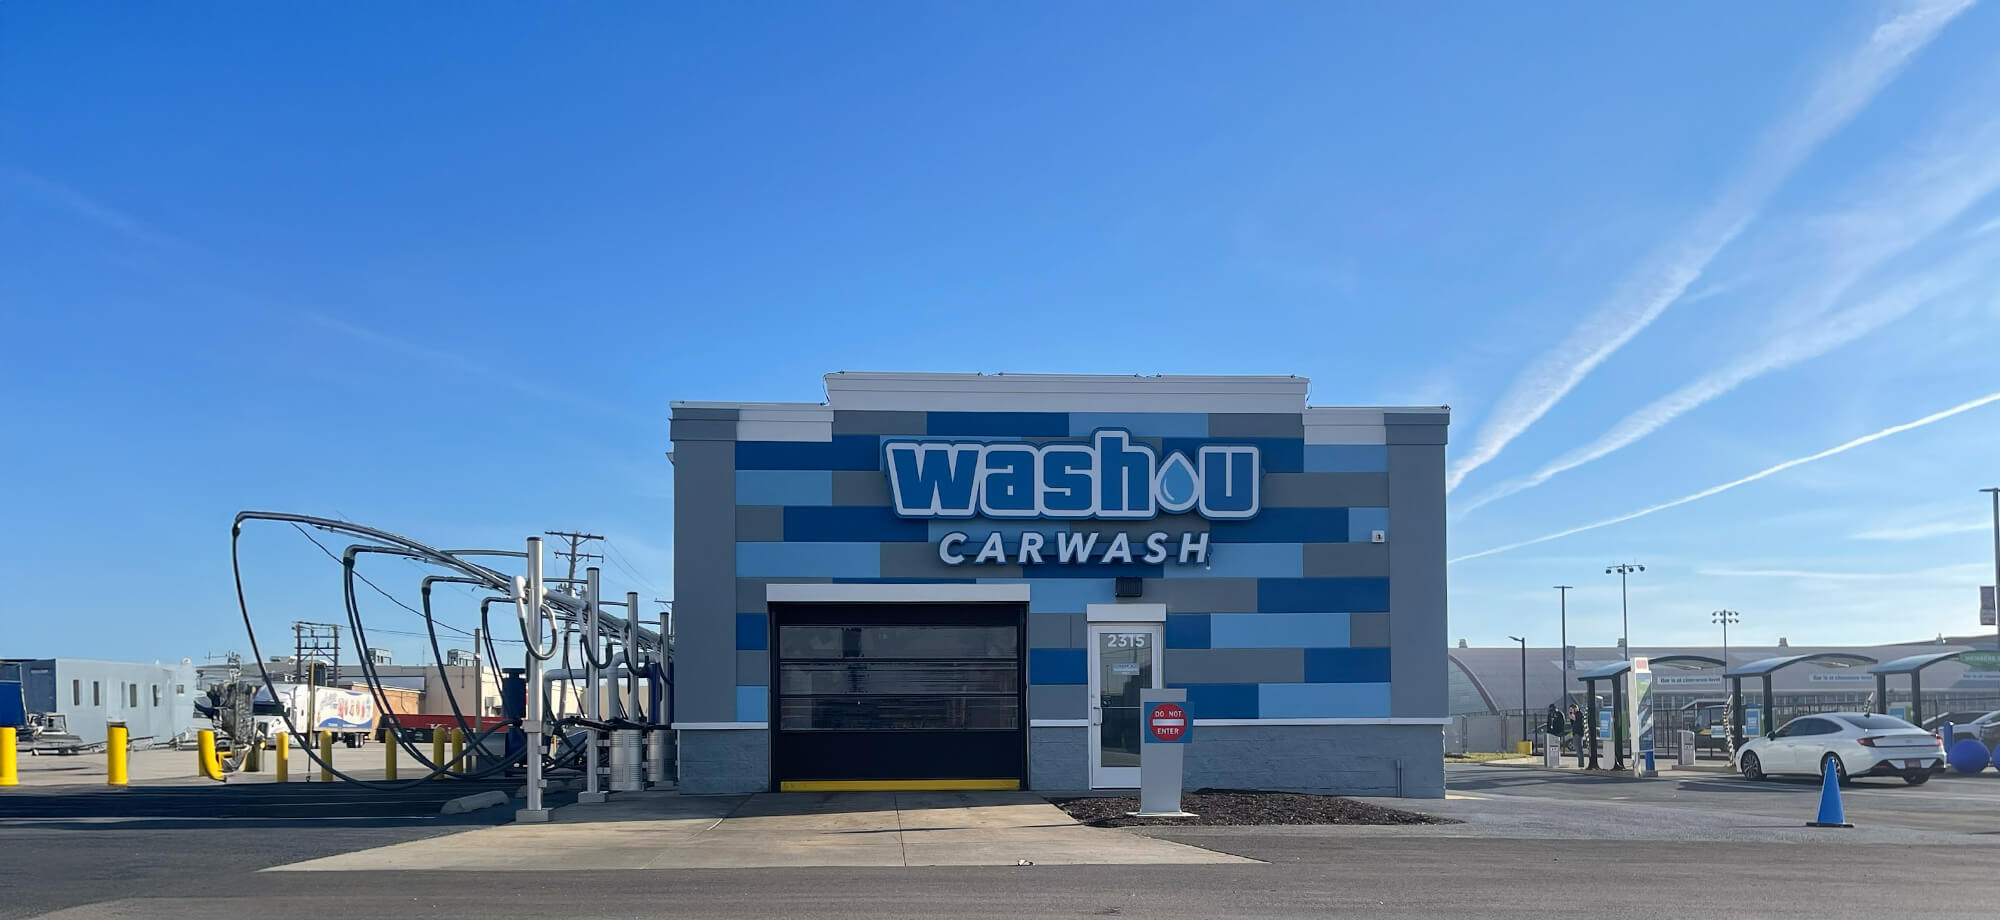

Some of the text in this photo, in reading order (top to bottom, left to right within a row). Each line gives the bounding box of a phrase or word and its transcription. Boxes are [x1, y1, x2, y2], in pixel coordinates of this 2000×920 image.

[939, 532, 1209, 564] CARWASH
[1107, 634, 1144, 647] 2315
[1169, 710, 1182, 718] NOT
[1157, 727, 1179, 735] ENTER
